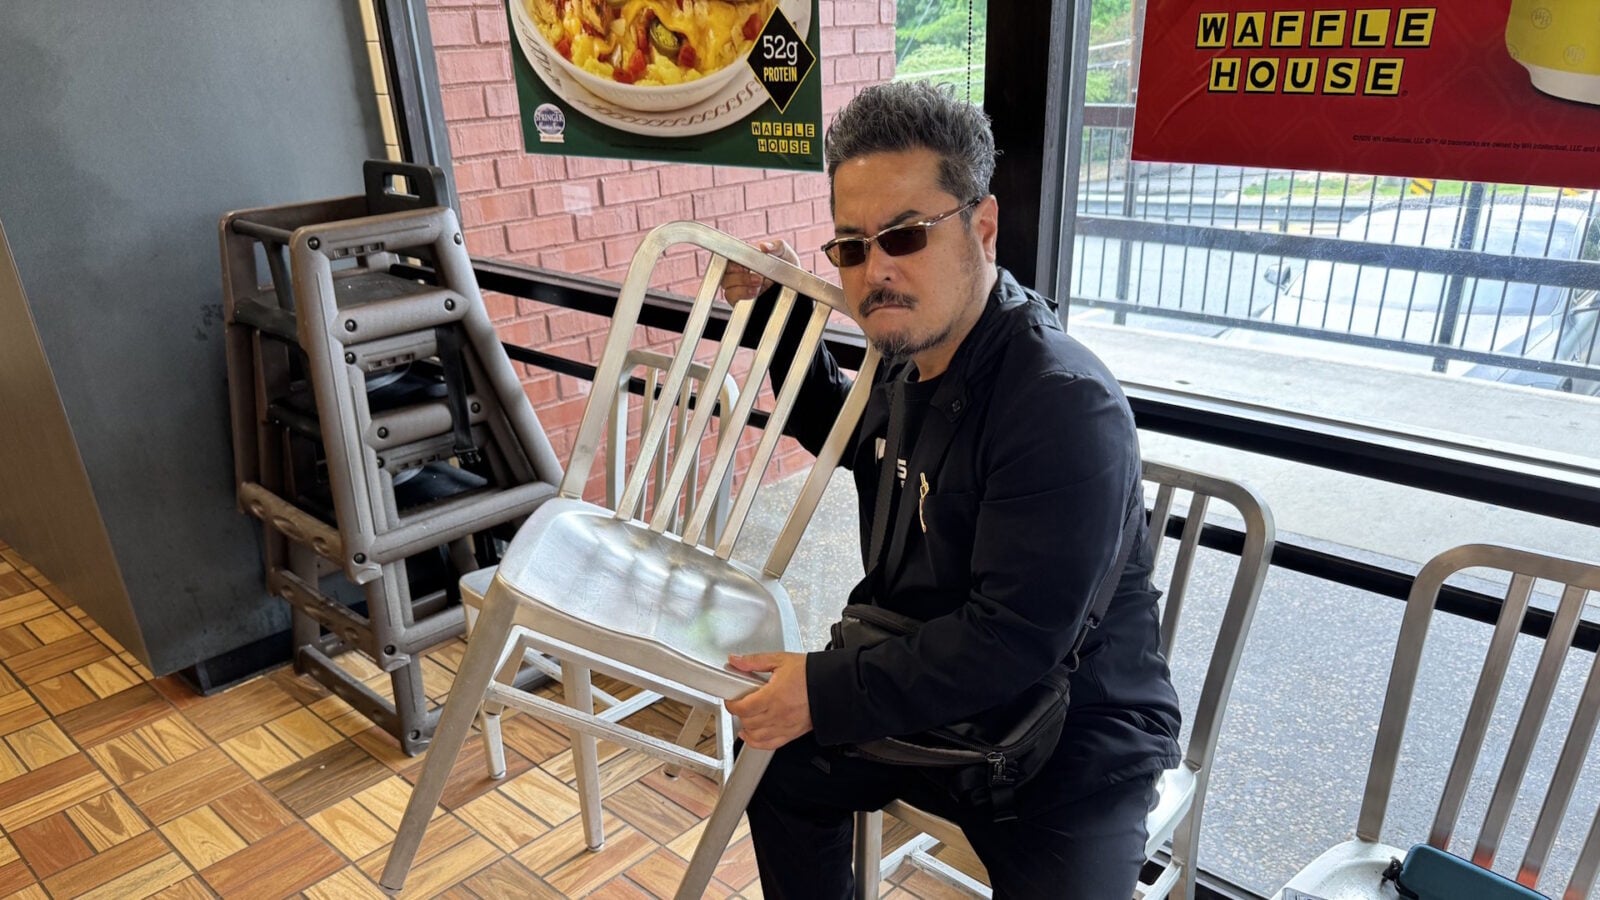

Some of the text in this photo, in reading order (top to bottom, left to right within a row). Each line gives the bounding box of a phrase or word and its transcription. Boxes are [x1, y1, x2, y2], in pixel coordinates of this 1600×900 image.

[1200, 11, 1431, 44] WAFFLE
[763, 35, 798, 65] 52g
[763, 67, 798, 82] PROTEIN
[1212, 59, 1399, 92] HOUSE
[752, 122, 814, 137] WAFFLE
[757, 139, 809, 154] HOUSE
